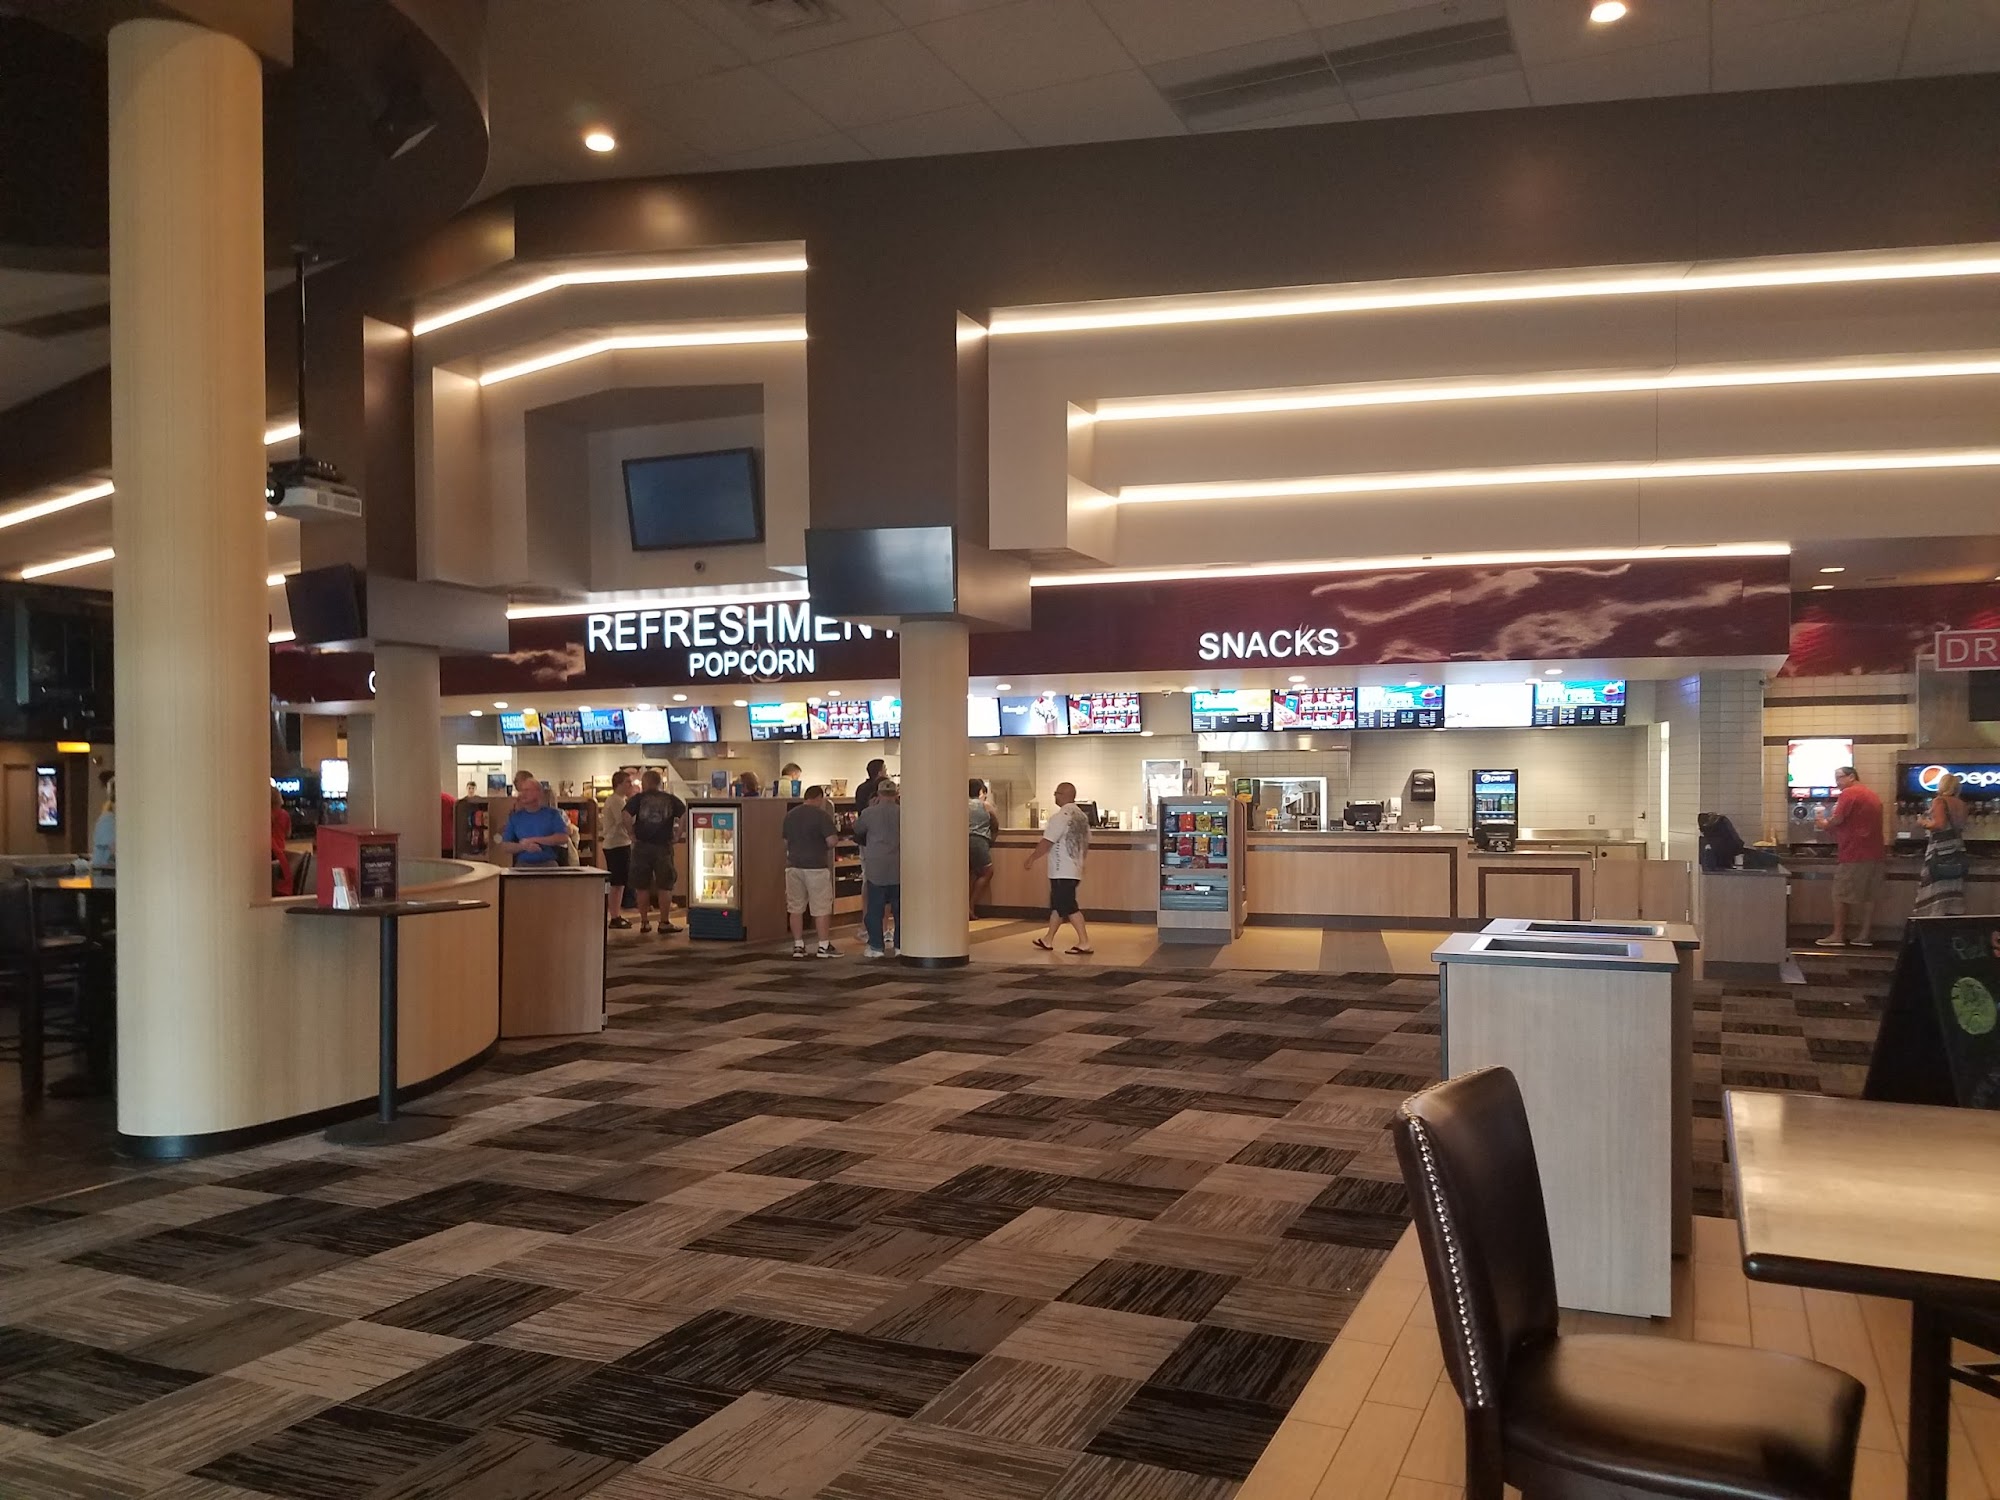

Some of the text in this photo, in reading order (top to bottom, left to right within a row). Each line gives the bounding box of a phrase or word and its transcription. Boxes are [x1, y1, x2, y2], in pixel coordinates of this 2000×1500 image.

[587, 601, 894, 653] REFRESHME
[1198, 628, 1340, 660] SNACKS
[1946, 637, 1998, 662] DR
[689, 648, 815, 678] POPCORN
